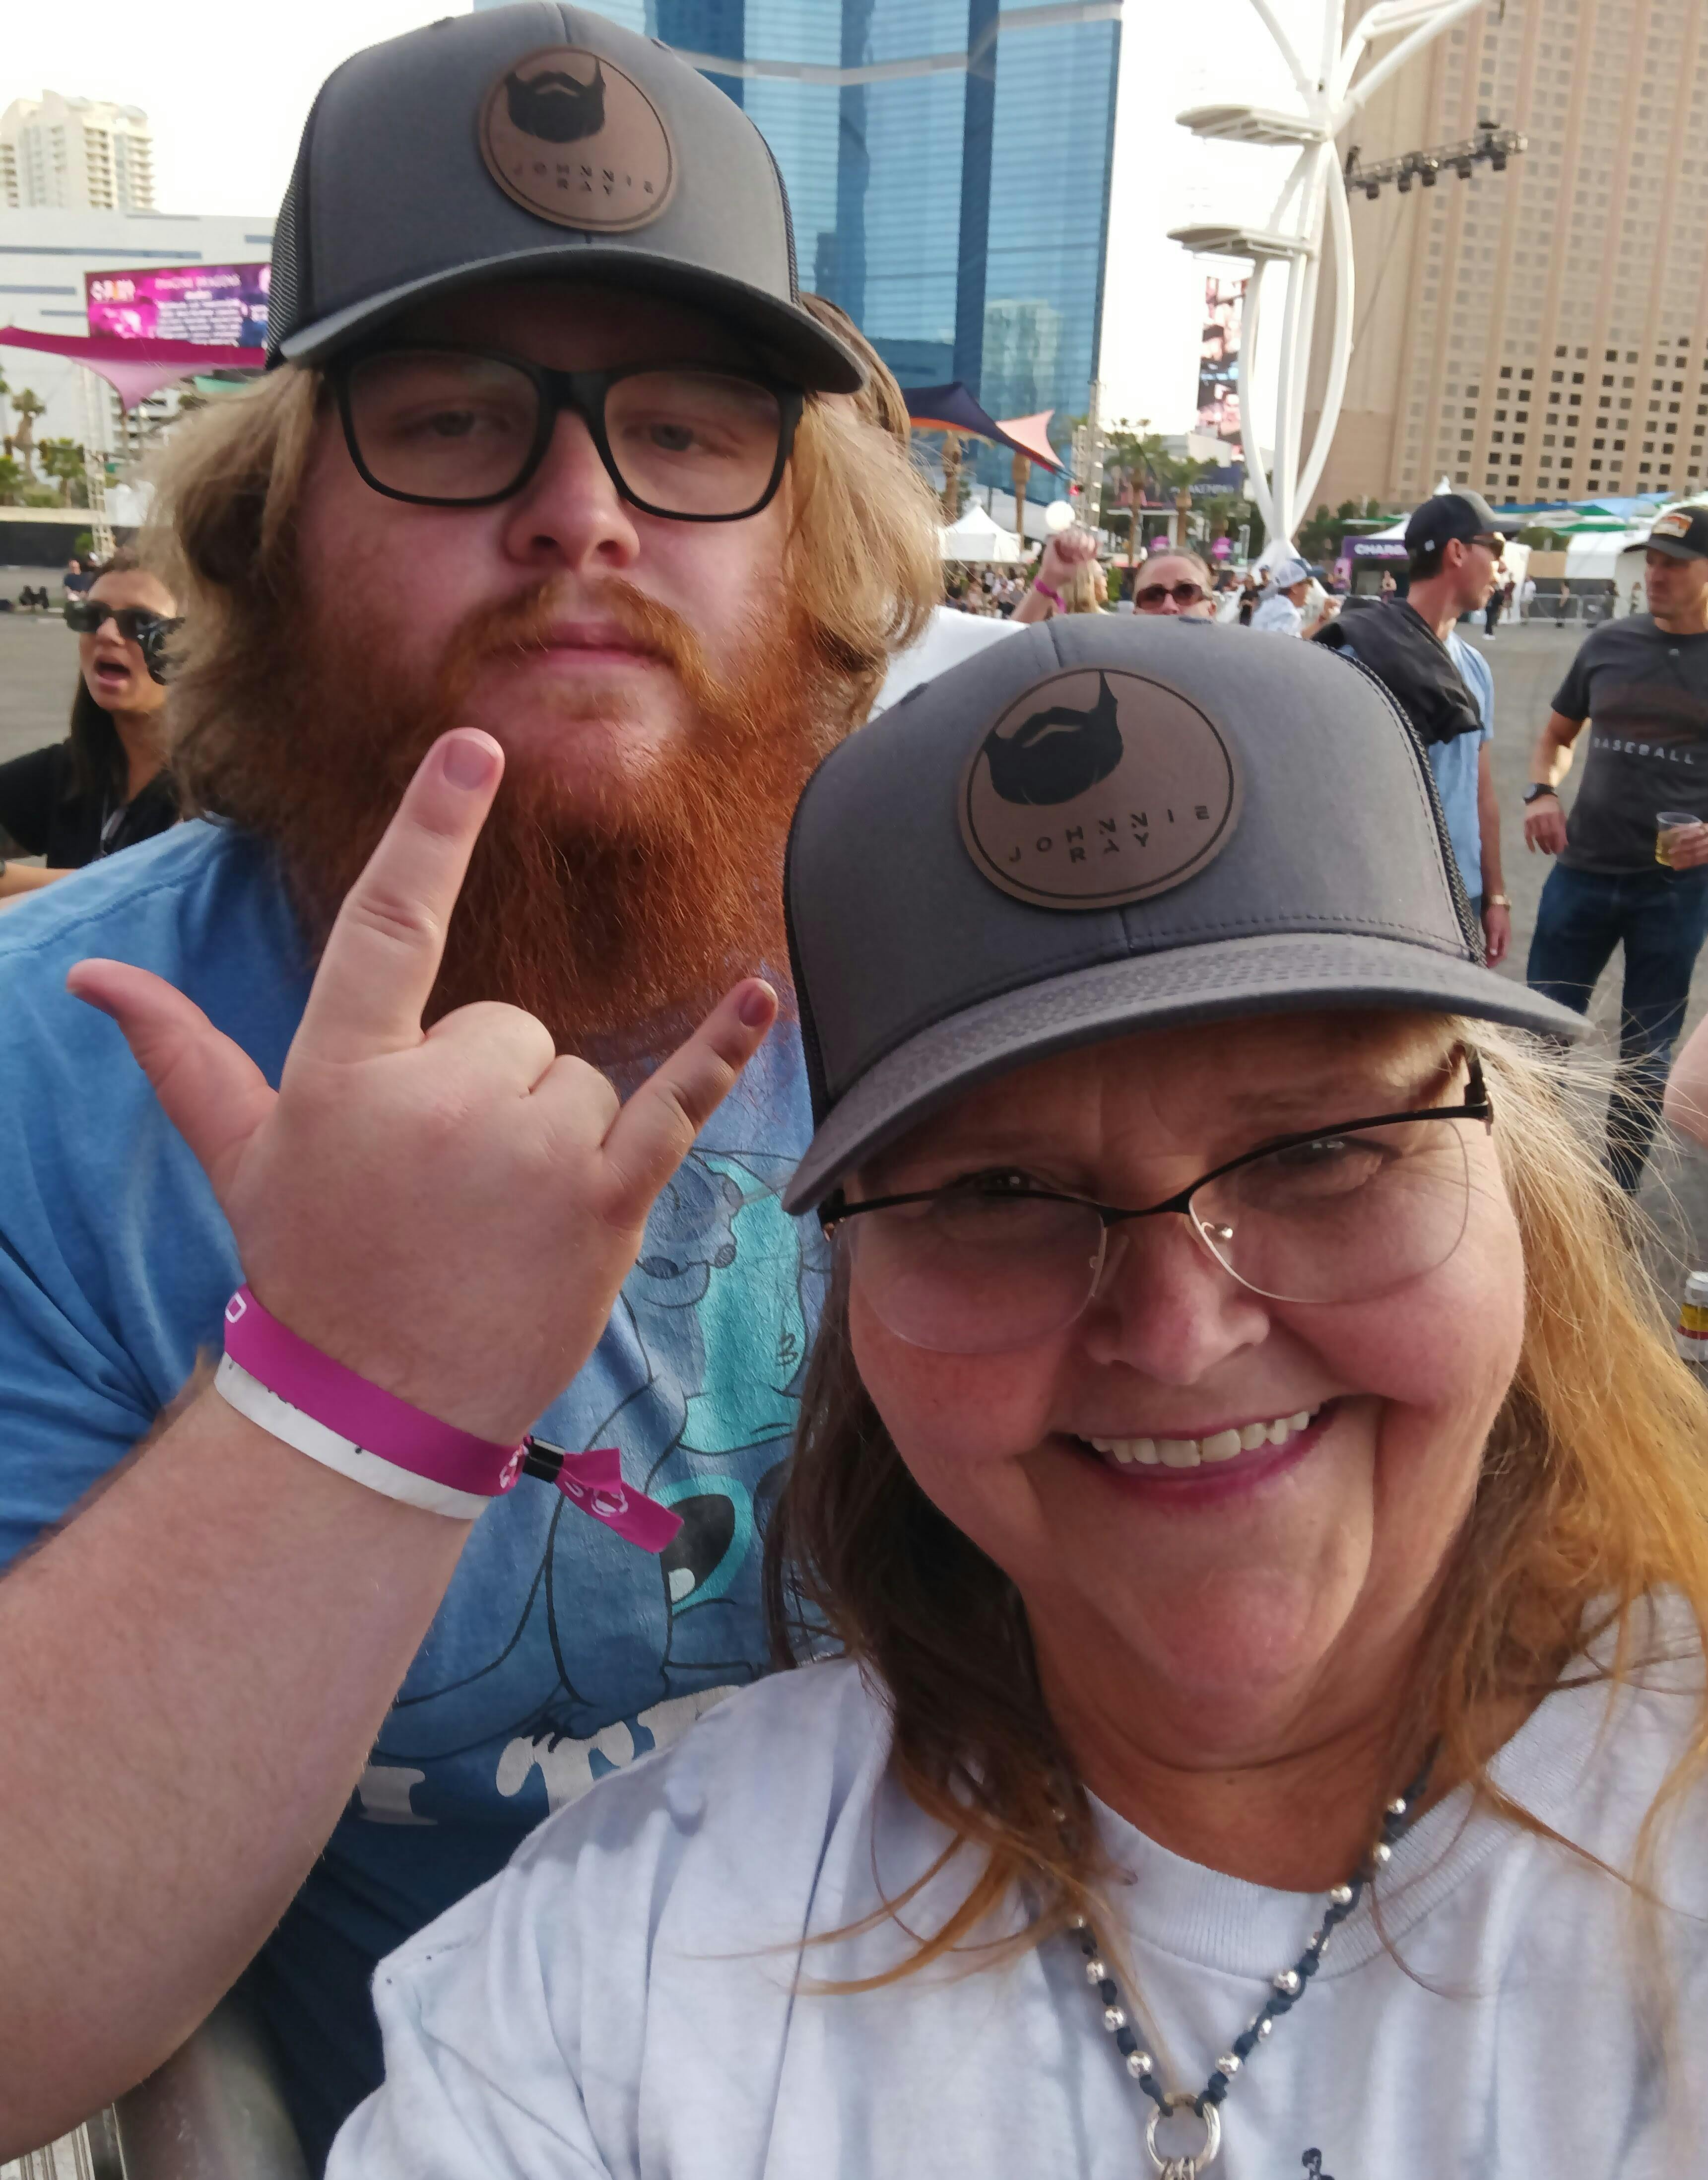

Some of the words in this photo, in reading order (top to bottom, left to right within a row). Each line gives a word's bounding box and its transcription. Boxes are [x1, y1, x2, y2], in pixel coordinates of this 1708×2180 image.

[1593, 737, 1695, 765] BASEBALL
[1009, 805, 1210, 863] JOHNNIE
[1069, 831, 1149, 863] RAY
